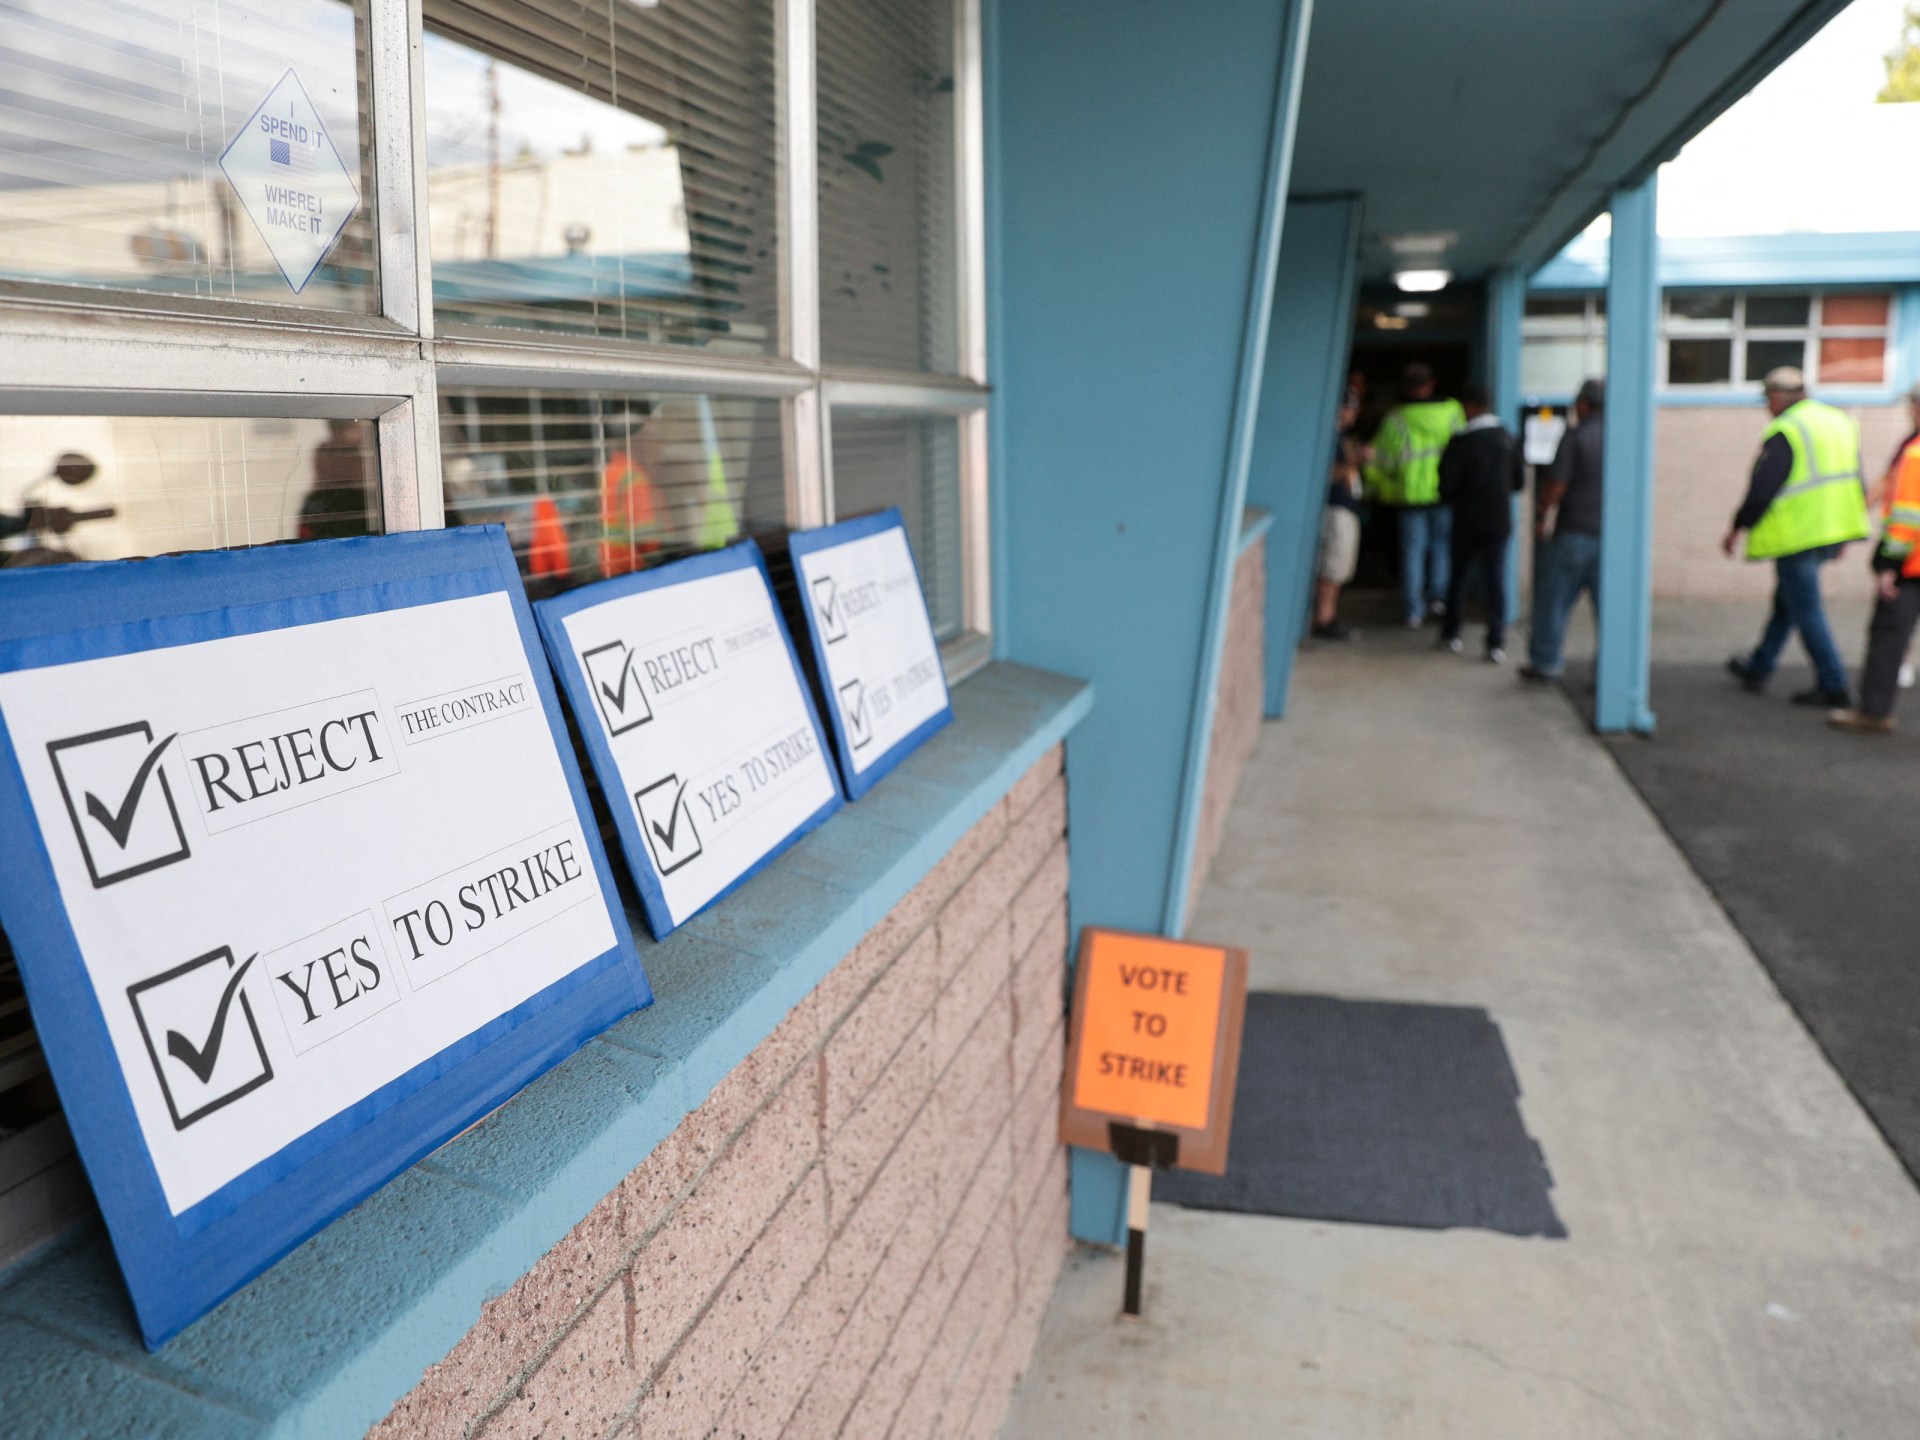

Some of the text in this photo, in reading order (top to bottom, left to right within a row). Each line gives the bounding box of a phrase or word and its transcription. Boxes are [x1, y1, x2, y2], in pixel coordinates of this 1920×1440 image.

[290, 101, 295, 118] I
[260, 115, 323, 148] SPEND IT
[264, 184, 322, 214] WHERE I
[266, 207, 322, 235] MAKE IT
[644, 637, 719, 694] REJECT
[190, 682, 526, 814] REJECT THE CONTRACT
[698, 725, 817, 823] YES TO STRIKE
[275, 839, 583, 1025] YES TO STRIKE
[1119, 963, 1190, 995] VOTE
[1132, 1009, 1168, 1038] TO
[1098, 1051, 1189, 1088] STRIKE
